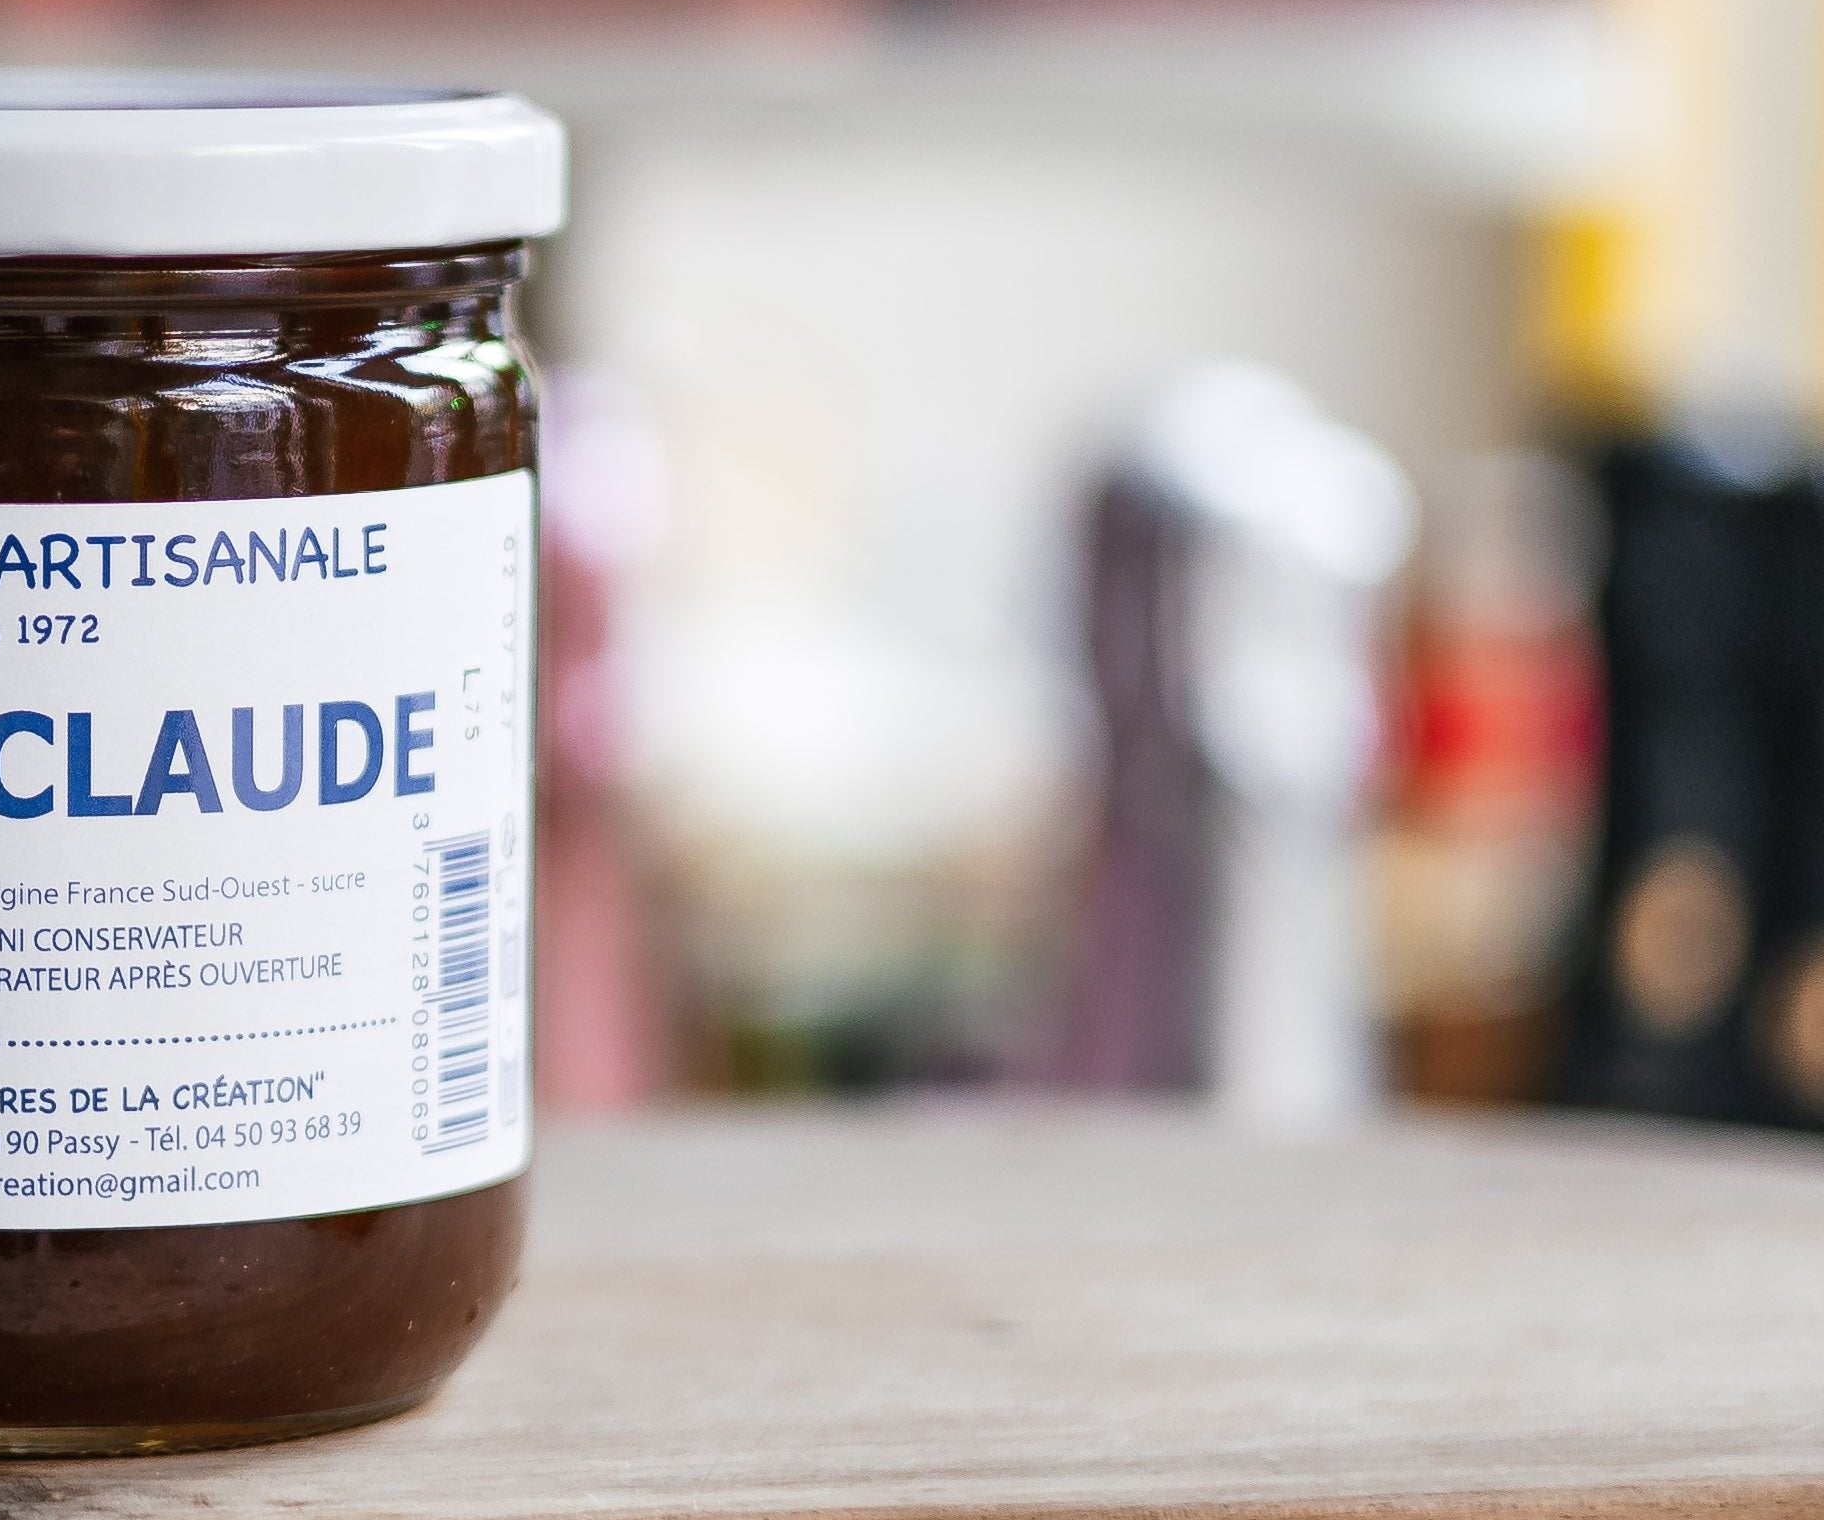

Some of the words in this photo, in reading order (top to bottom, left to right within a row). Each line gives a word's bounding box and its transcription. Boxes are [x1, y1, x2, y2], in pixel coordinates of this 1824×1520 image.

[17, 613, 100, 645] 1972
[67, 881, 155, 905] France
[162, 876, 290, 903] Sud-Ouest
[311, 871, 366, 893] sucre
[33, 924, 243, 952] CONSERVATEUR
[108, 959, 192, 991] APRÈS
[199, 952, 342, 987] OUVERTURE
[69, 1087, 109, 1114] DE
[122, 1084, 160, 1112] LA
[172, 1070, 325, 1111] CRÉATION"
[48, 1129, 120, 1161] Passy
[144, 1124, 188, 1152] Tél.
[195, 1124, 227, 1150] 04
[233, 1121, 263, 1148] 50
[270, 1118, 297, 1145] 93
[304, 1114, 331, 1141] 68
[337, 1110, 362, 1137] 39
